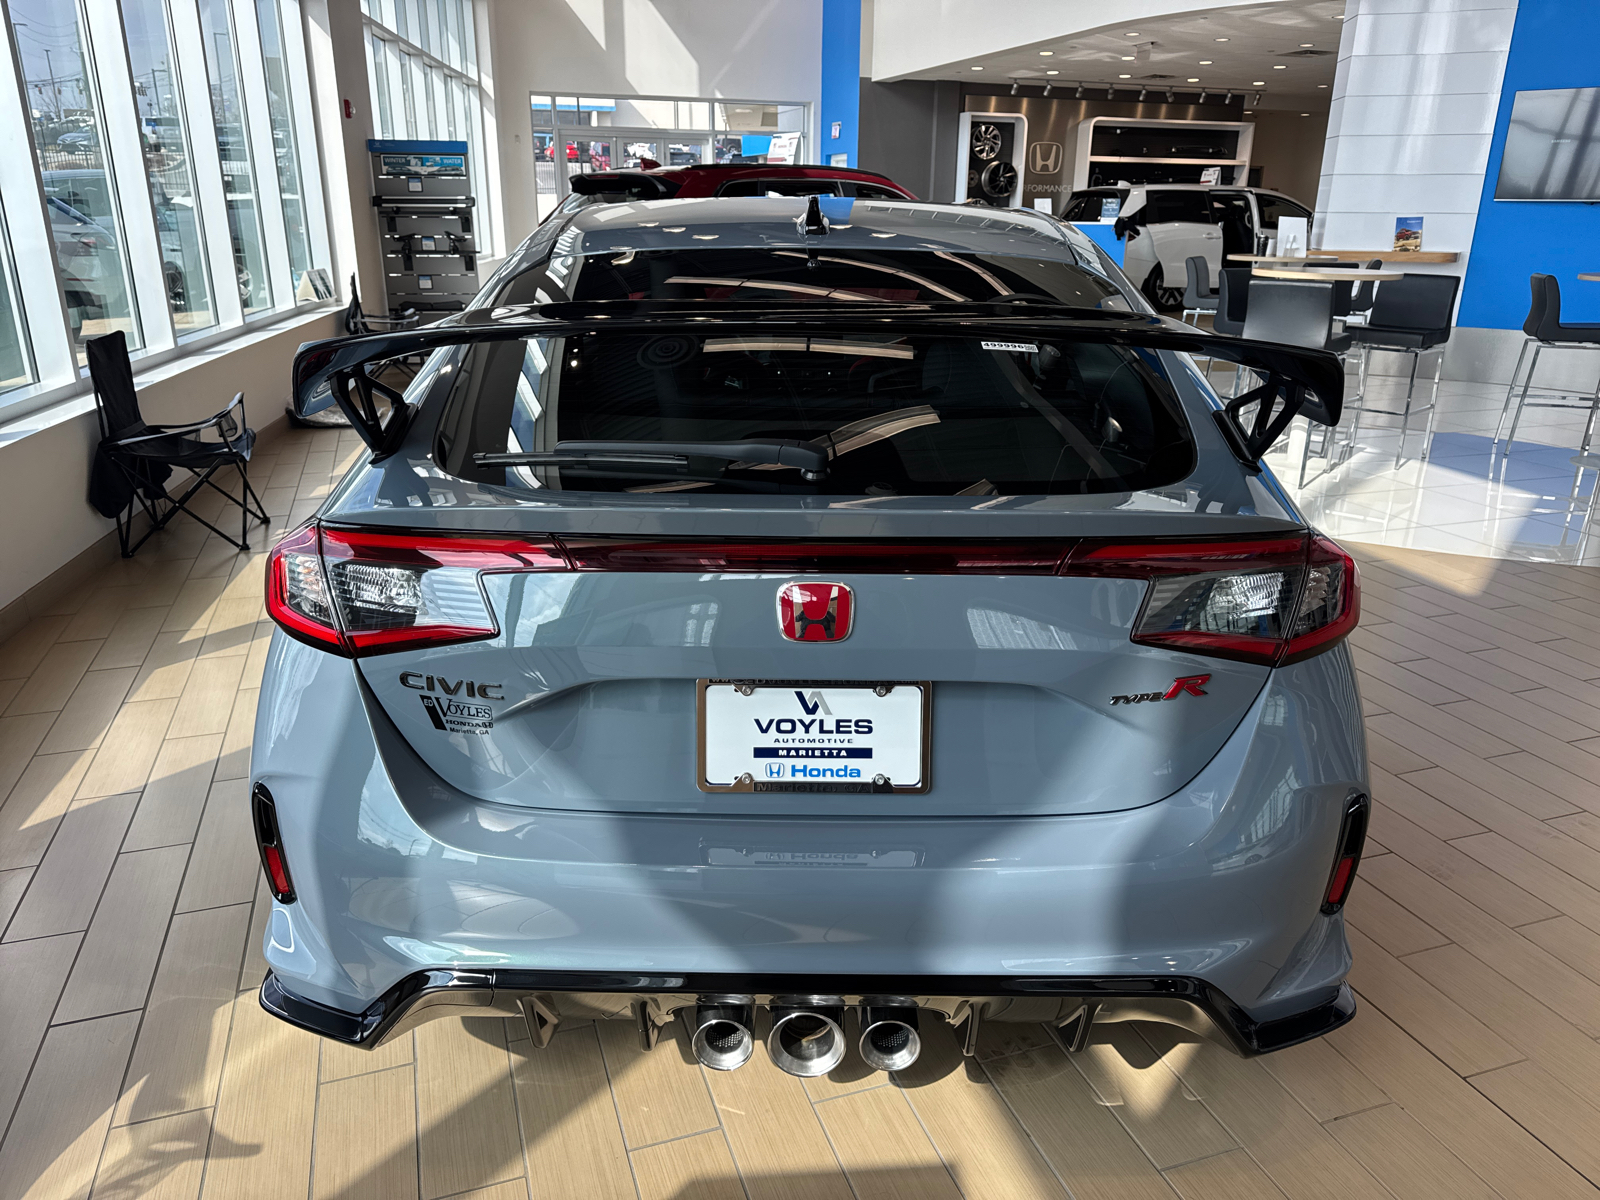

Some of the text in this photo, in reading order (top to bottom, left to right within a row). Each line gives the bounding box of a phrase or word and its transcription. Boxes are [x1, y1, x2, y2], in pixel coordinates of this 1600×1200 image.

[399, 670, 505, 700] CIVIC
[1109, 673, 1212, 706] TYPE R
[423, 696, 492, 719] ED VOYLES
[445, 719, 483, 728] HONDA
[754, 718, 873, 734] VOYLES
[449, 727, 479, 736] Marietta,
[778, 749, 848, 757] MARIETTA
[791, 764, 861, 778] Honda
